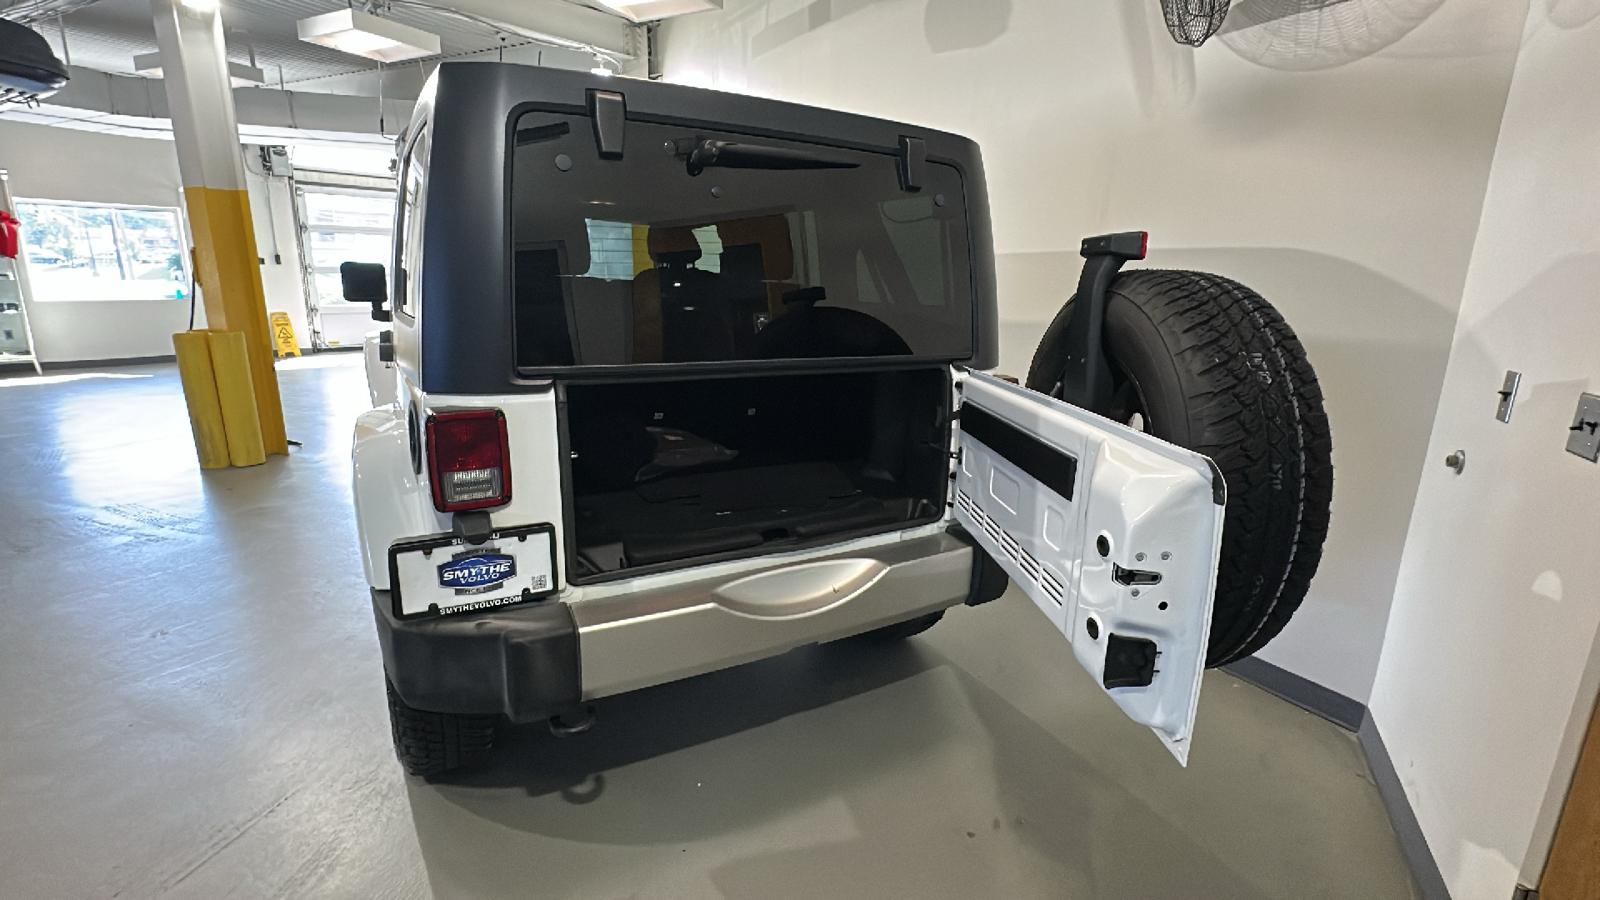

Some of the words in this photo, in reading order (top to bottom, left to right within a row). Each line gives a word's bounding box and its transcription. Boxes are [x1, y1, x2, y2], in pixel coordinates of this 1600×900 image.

[443, 563, 511, 580] SMYTHE
[460, 573, 500, 584] VOLVO
[440, 596, 522, 615] SMYTHEVOLVO.COM
